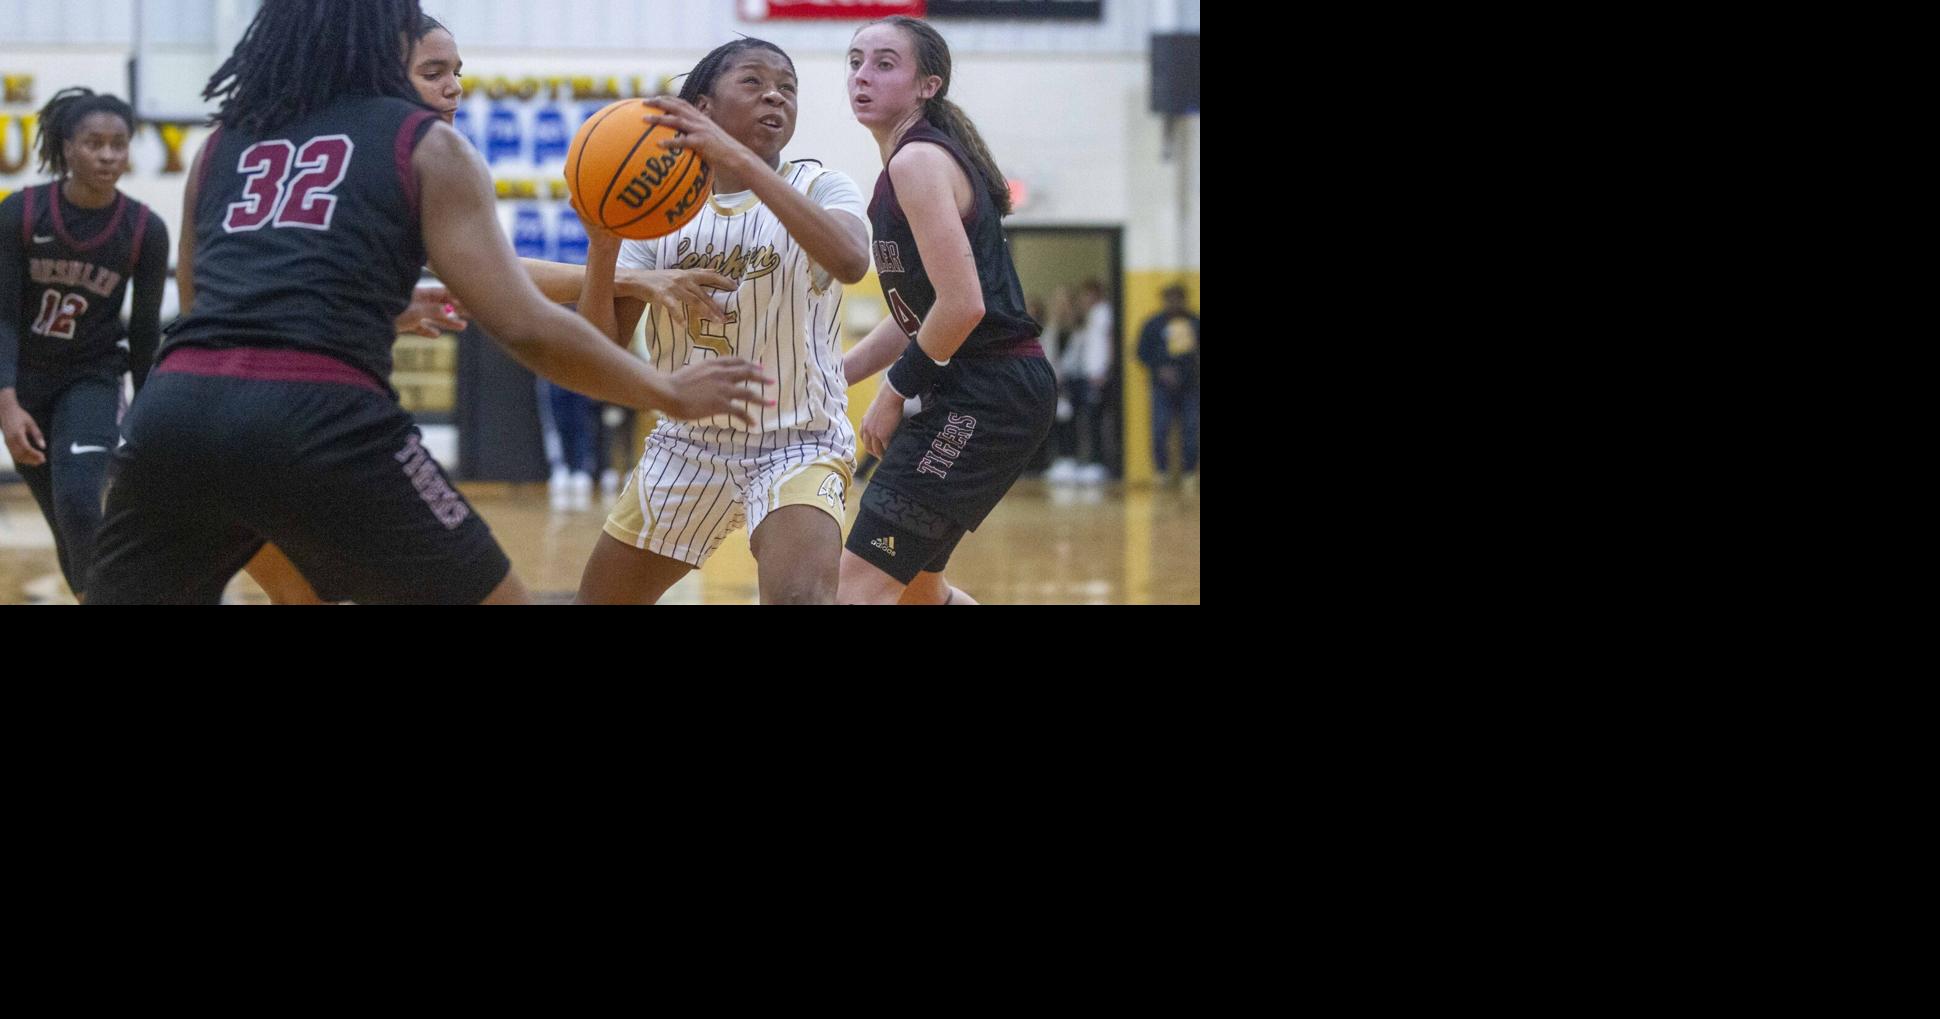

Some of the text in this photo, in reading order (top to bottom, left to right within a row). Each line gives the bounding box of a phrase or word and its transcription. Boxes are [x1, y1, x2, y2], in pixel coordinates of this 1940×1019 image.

[222, 134, 354, 234] 32
[31, 288, 88, 340] 12
[888, 288, 921, 337] 4
[917, 411, 977, 480] TIGERS
[870, 539, 896, 557] adidas
